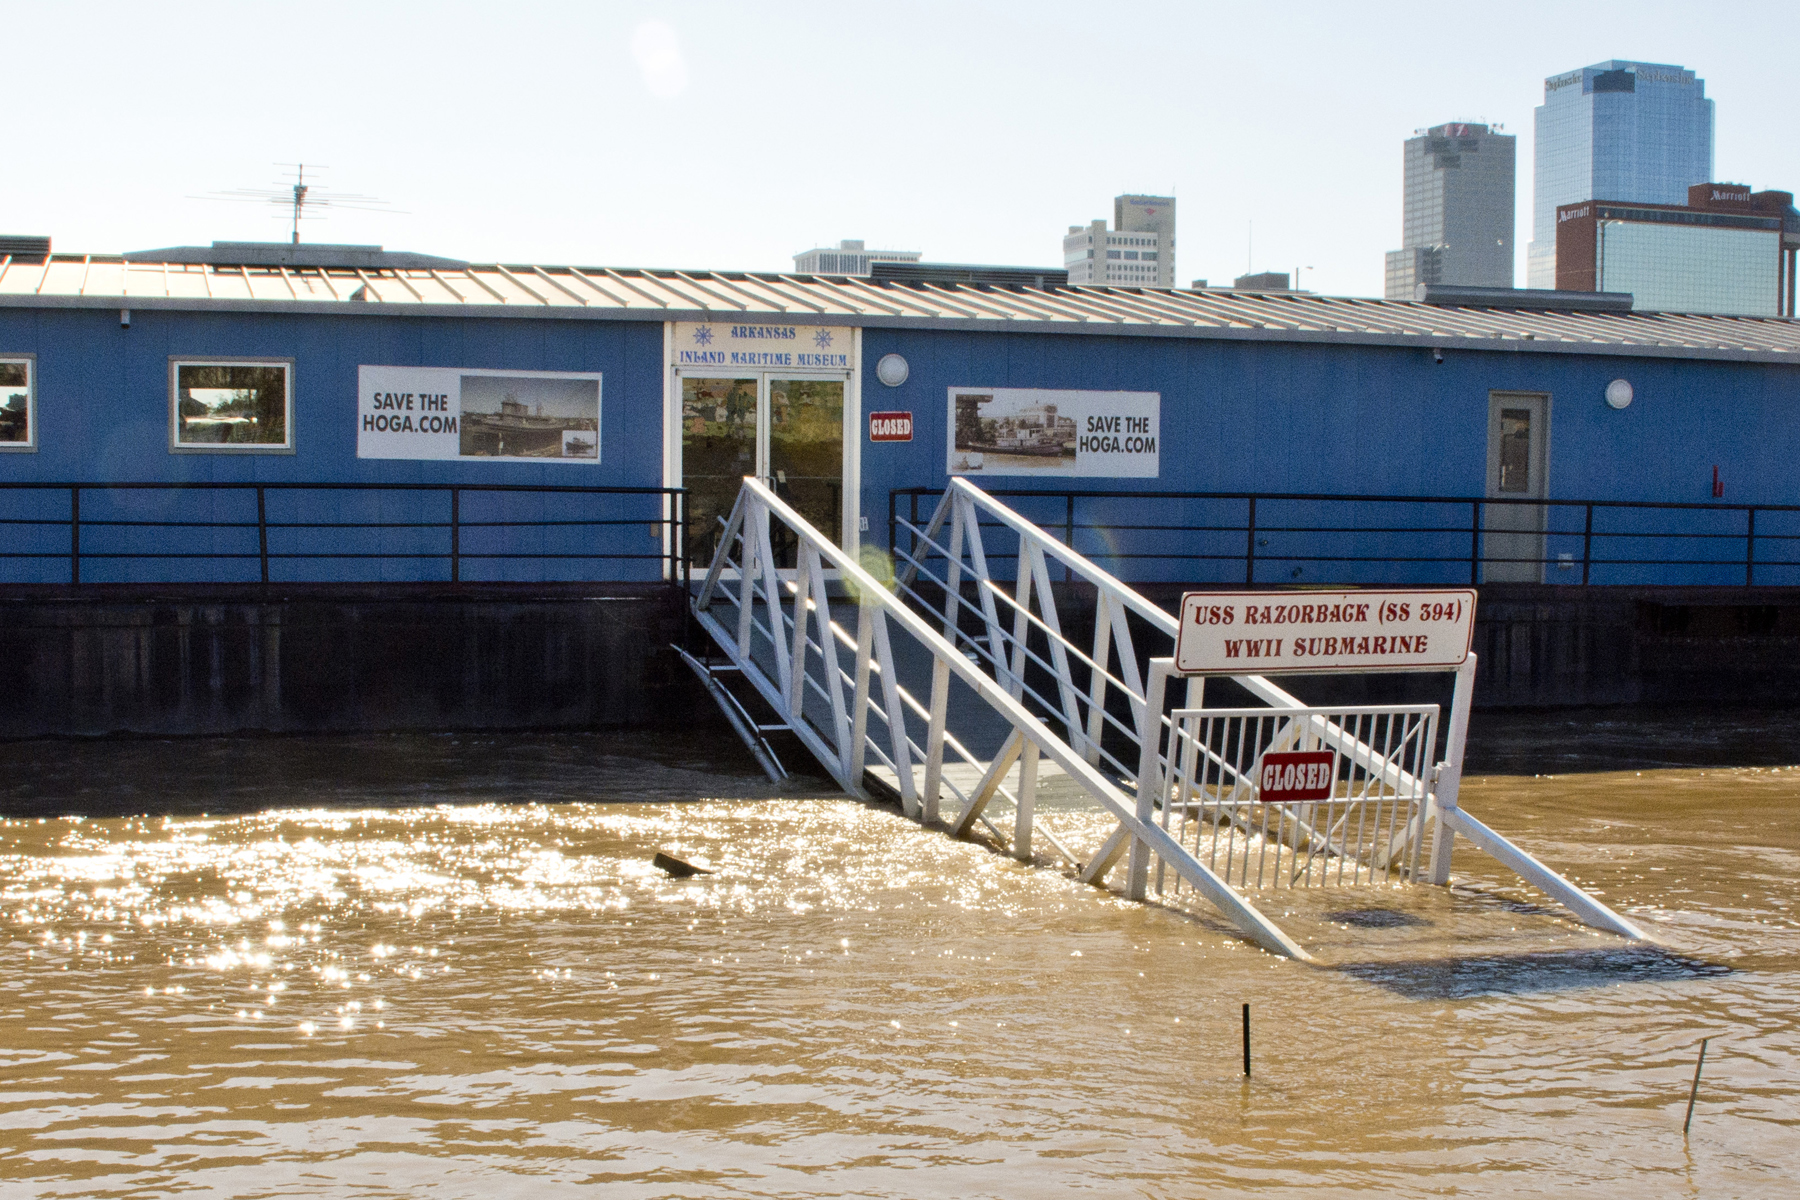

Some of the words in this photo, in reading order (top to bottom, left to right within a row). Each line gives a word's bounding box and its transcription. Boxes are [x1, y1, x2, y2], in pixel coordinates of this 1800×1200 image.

[1710, 189, 1751, 202] Marriott
[1558, 206, 1590, 223] Marriott
[731, 326, 796, 340] ARKANSAS
[680, 351, 725, 364] INLAND
[730, 352, 792, 366] MARITIME
[797, 354, 847, 367] MUSEUM
[373, 393, 413, 410] SAVE
[419, 394, 448, 411] THE
[363, 415, 457, 433] HOGA.COM
[871, 419, 911, 435] CLOSED
[1087, 416, 1121, 433] SAVE
[1125, 417, 1149, 433] THE
[1080, 436, 1156, 453] HOGA.COM
[1194, 605, 1234, 625] USS
[1244, 603, 1370, 624] RAZORBACK
[1378, 600, 1411, 625] (SS
[1419, 599, 1462, 623] 394)
[1224, 638, 1282, 658] WWII
[1293, 635, 1429, 657] SUBMARINE
[1262, 762, 1331, 791] CLOSED
